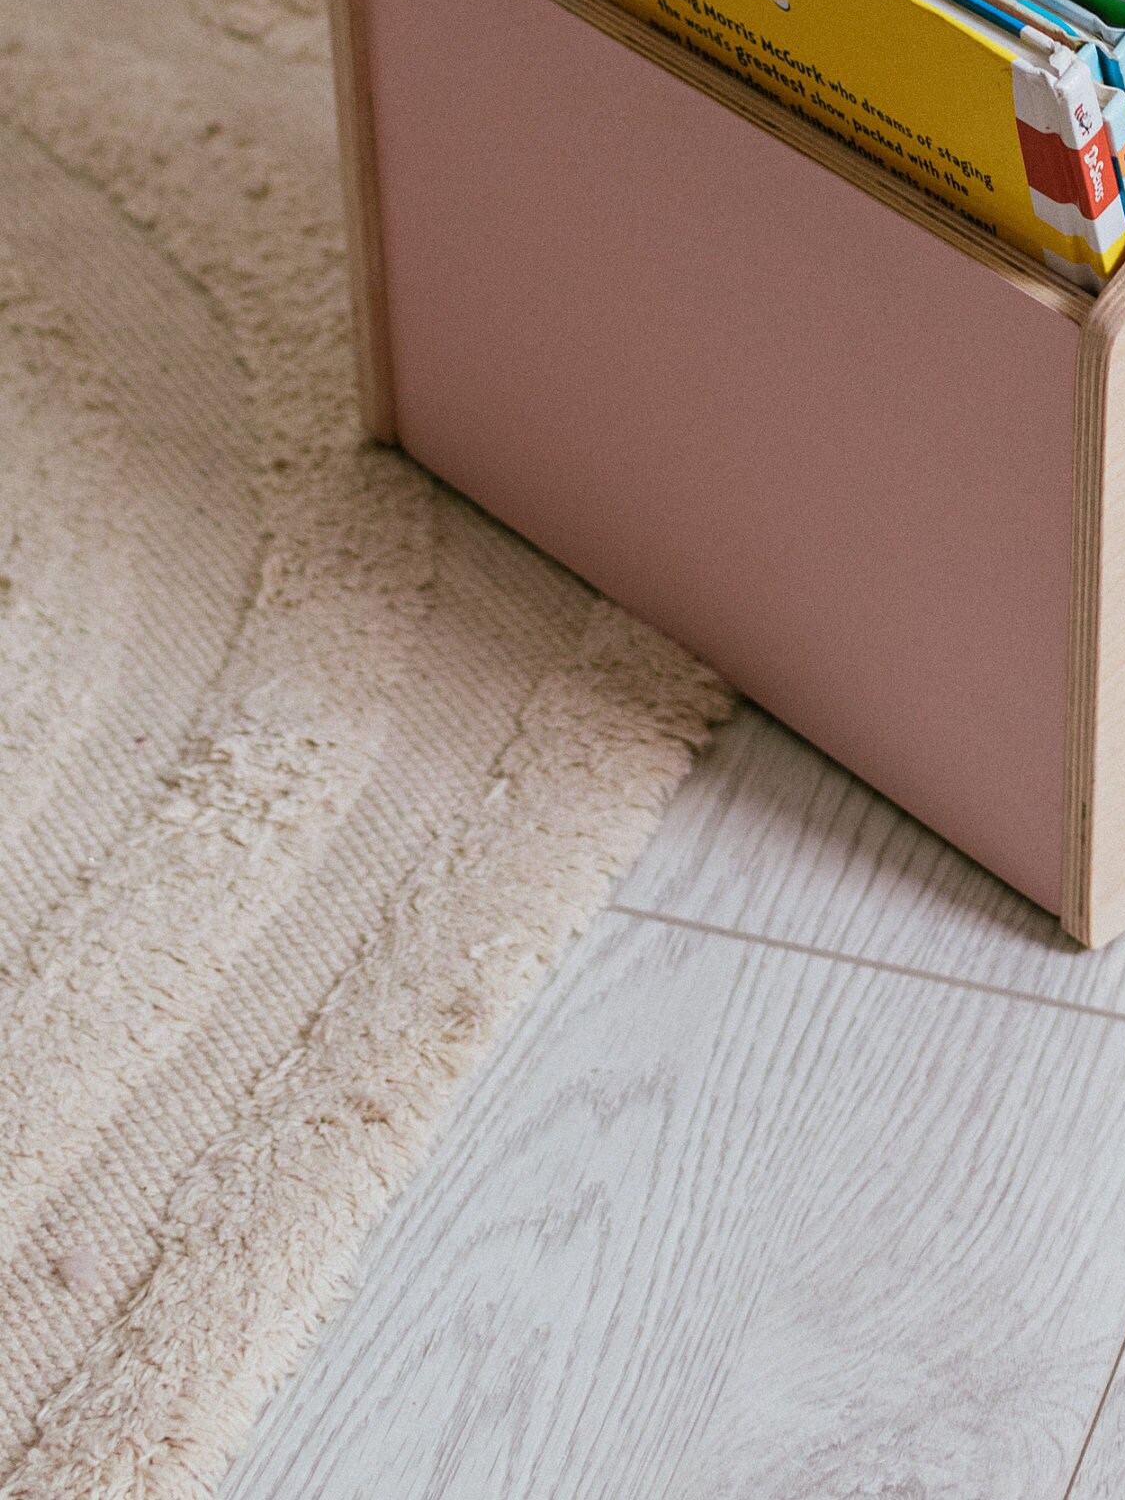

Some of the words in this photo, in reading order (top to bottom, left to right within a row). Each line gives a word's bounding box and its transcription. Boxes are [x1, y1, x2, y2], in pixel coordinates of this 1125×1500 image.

[684, 17, 732, 52] world's
[735, 45, 806, 98] greatest
[852, 117, 904, 158] packed
[907, 150, 940, 179] with
[944, 173, 969, 196] the
[703, 1, 757, 45] Morris
[760, 36, 826, 86] McGurk
[828, 80, 857, 105] who
[861, 99, 914, 139] dreams
[916, 134, 933, 150] of
[937, 146, 995, 192] staging
